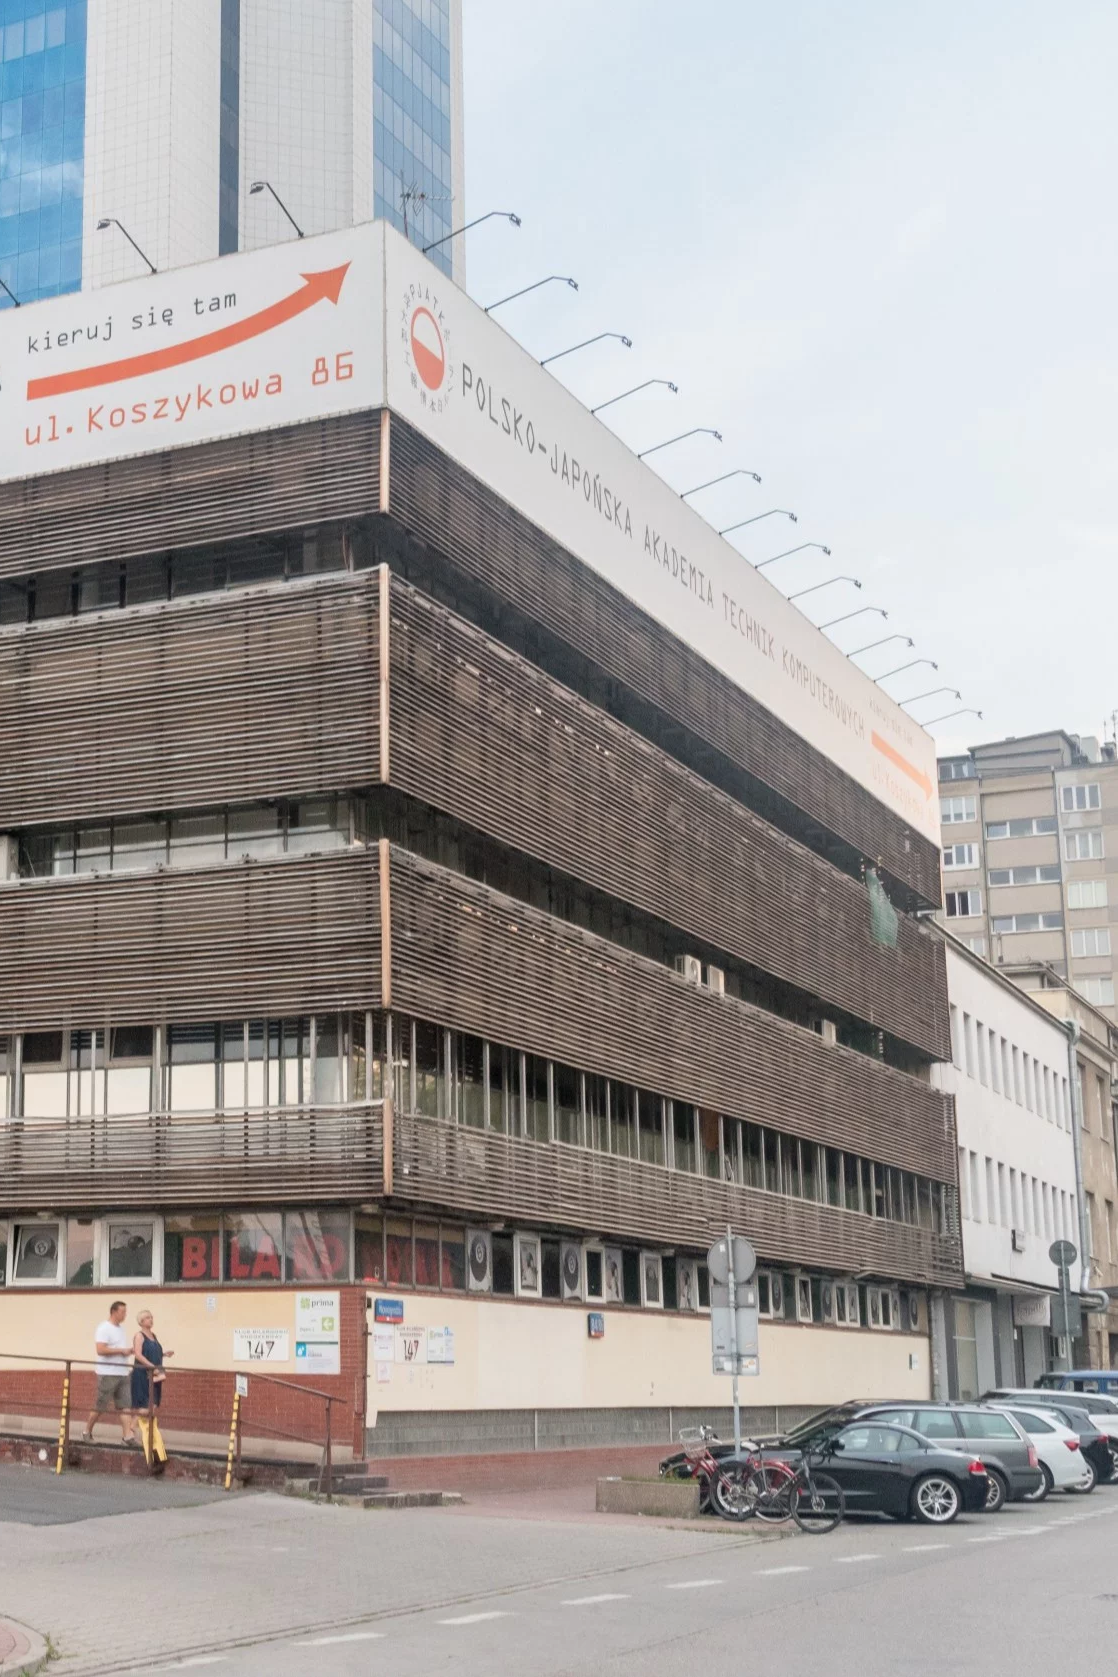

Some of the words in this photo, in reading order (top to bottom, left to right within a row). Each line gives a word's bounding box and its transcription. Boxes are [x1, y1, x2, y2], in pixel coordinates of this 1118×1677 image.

[27, 316, 114, 354] kieruj
[131, 306, 174, 330] się
[194, 291, 238, 316] tam
[311, 350, 354, 387] 86
[462, 362, 633, 539] POLSKO-JAPOŃSKA
[644, 524, 714, 609] AKADEMIA
[722, 591, 775, 662] TECHNIK
[782, 646, 865, 740] KOMPUTEROWYCH
[311, 1298, 334, 1308] prima
[247, 1341, 275, 1358] 147
[404, 1339, 419, 1359] 147
